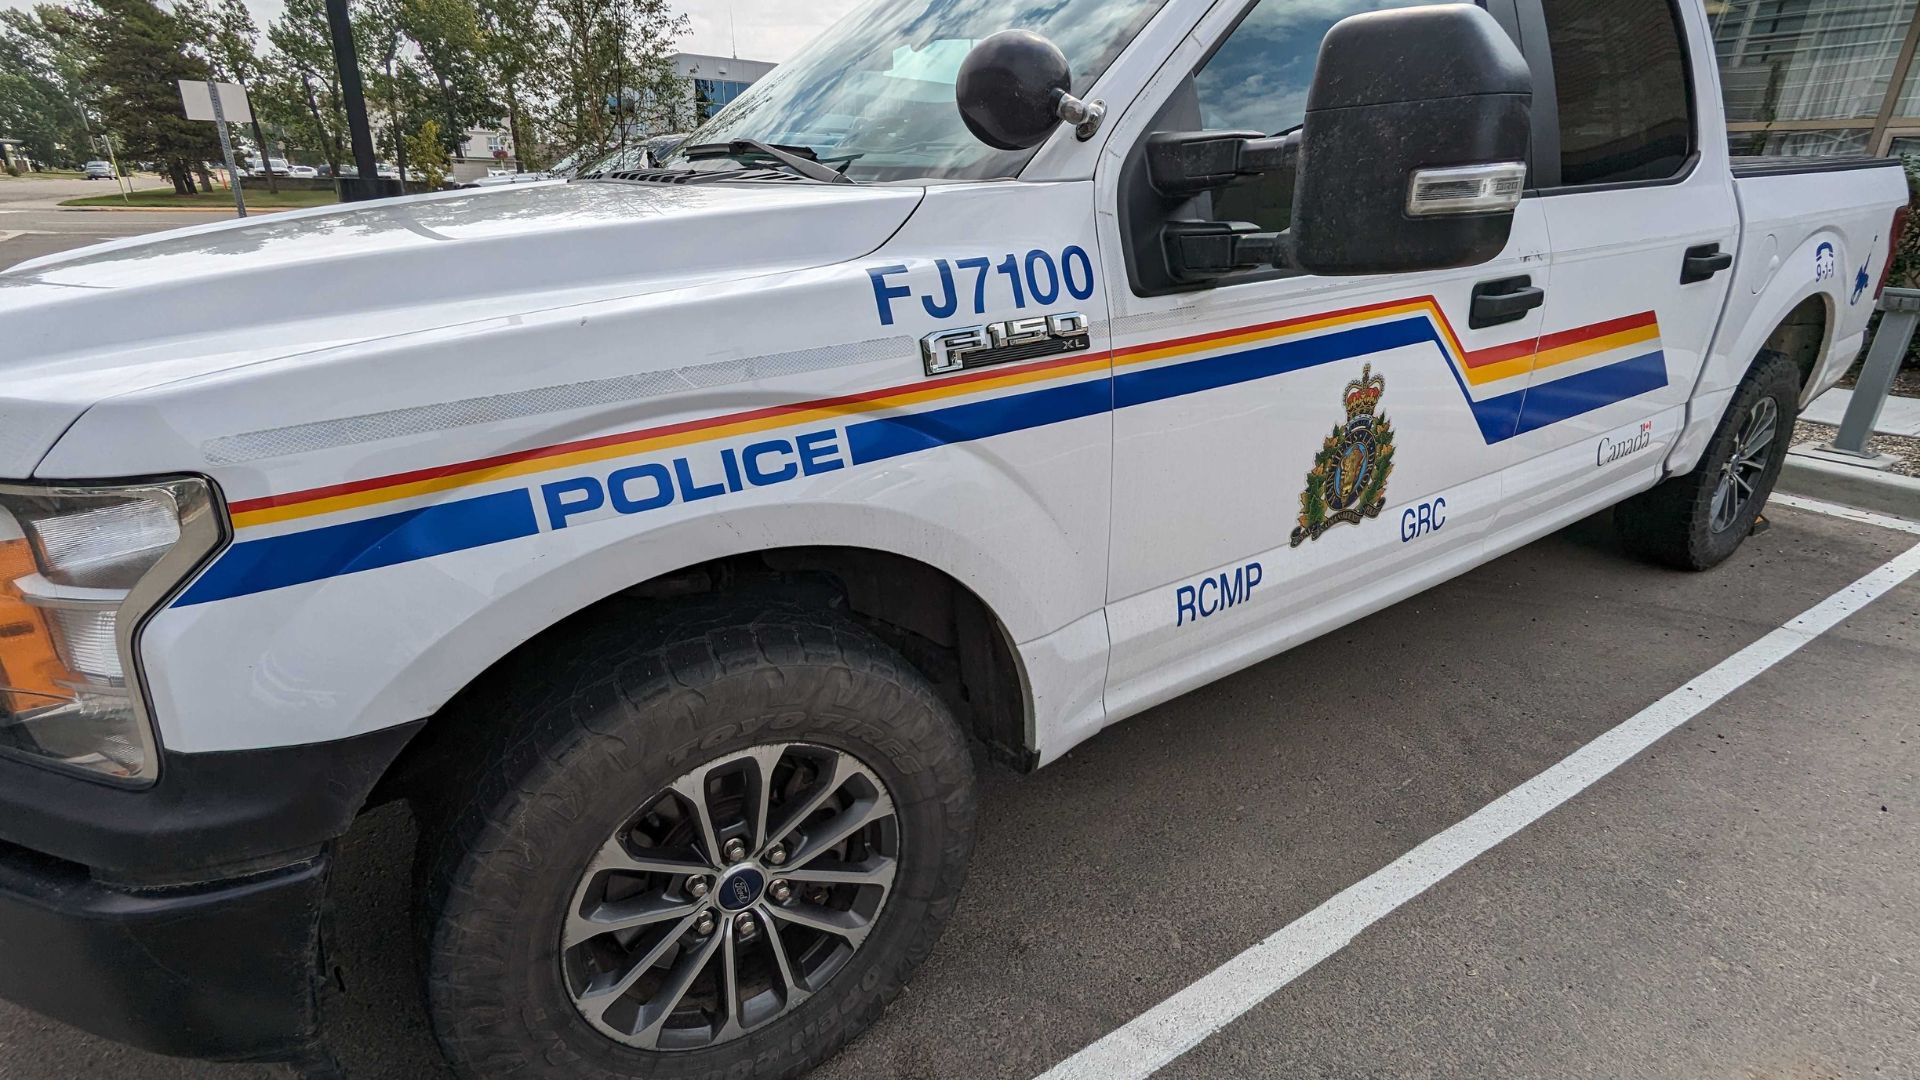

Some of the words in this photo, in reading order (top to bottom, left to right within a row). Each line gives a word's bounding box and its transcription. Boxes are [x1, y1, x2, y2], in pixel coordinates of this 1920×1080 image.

[865, 245, 1095, 326] FJ7100
[1062, 338, 1085, 350] XL
[1597, 424, 1650, 467] Canada
[541, 428, 845, 531] POLICE
[1401, 497, 1446, 543] GRC
[1176, 562, 1263, 627] RCMP
